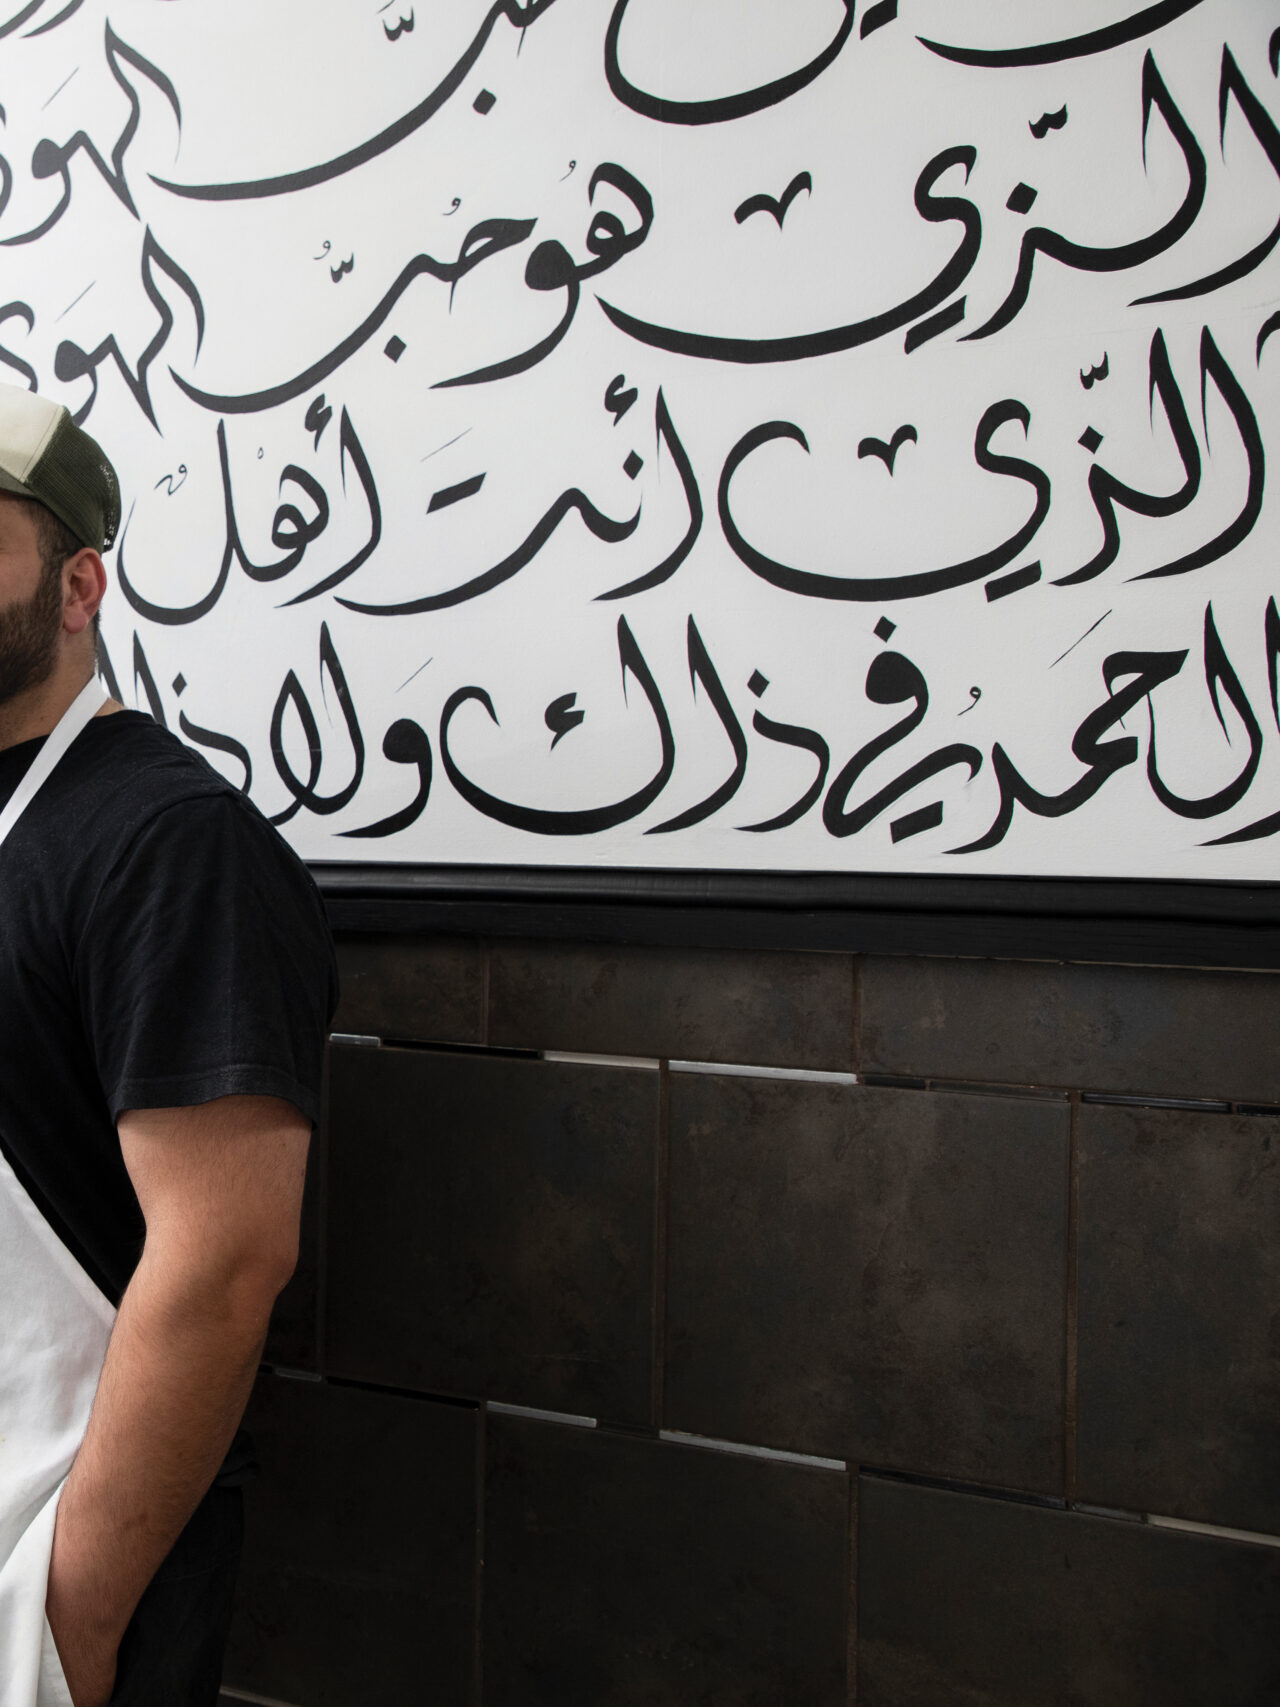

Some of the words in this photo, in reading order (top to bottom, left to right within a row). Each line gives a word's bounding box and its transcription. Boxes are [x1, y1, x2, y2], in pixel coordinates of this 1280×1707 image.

[430, 161, 655, 390] هو
[332, 372, 704, 617] أنت
[822, 616, 984, 846] في
